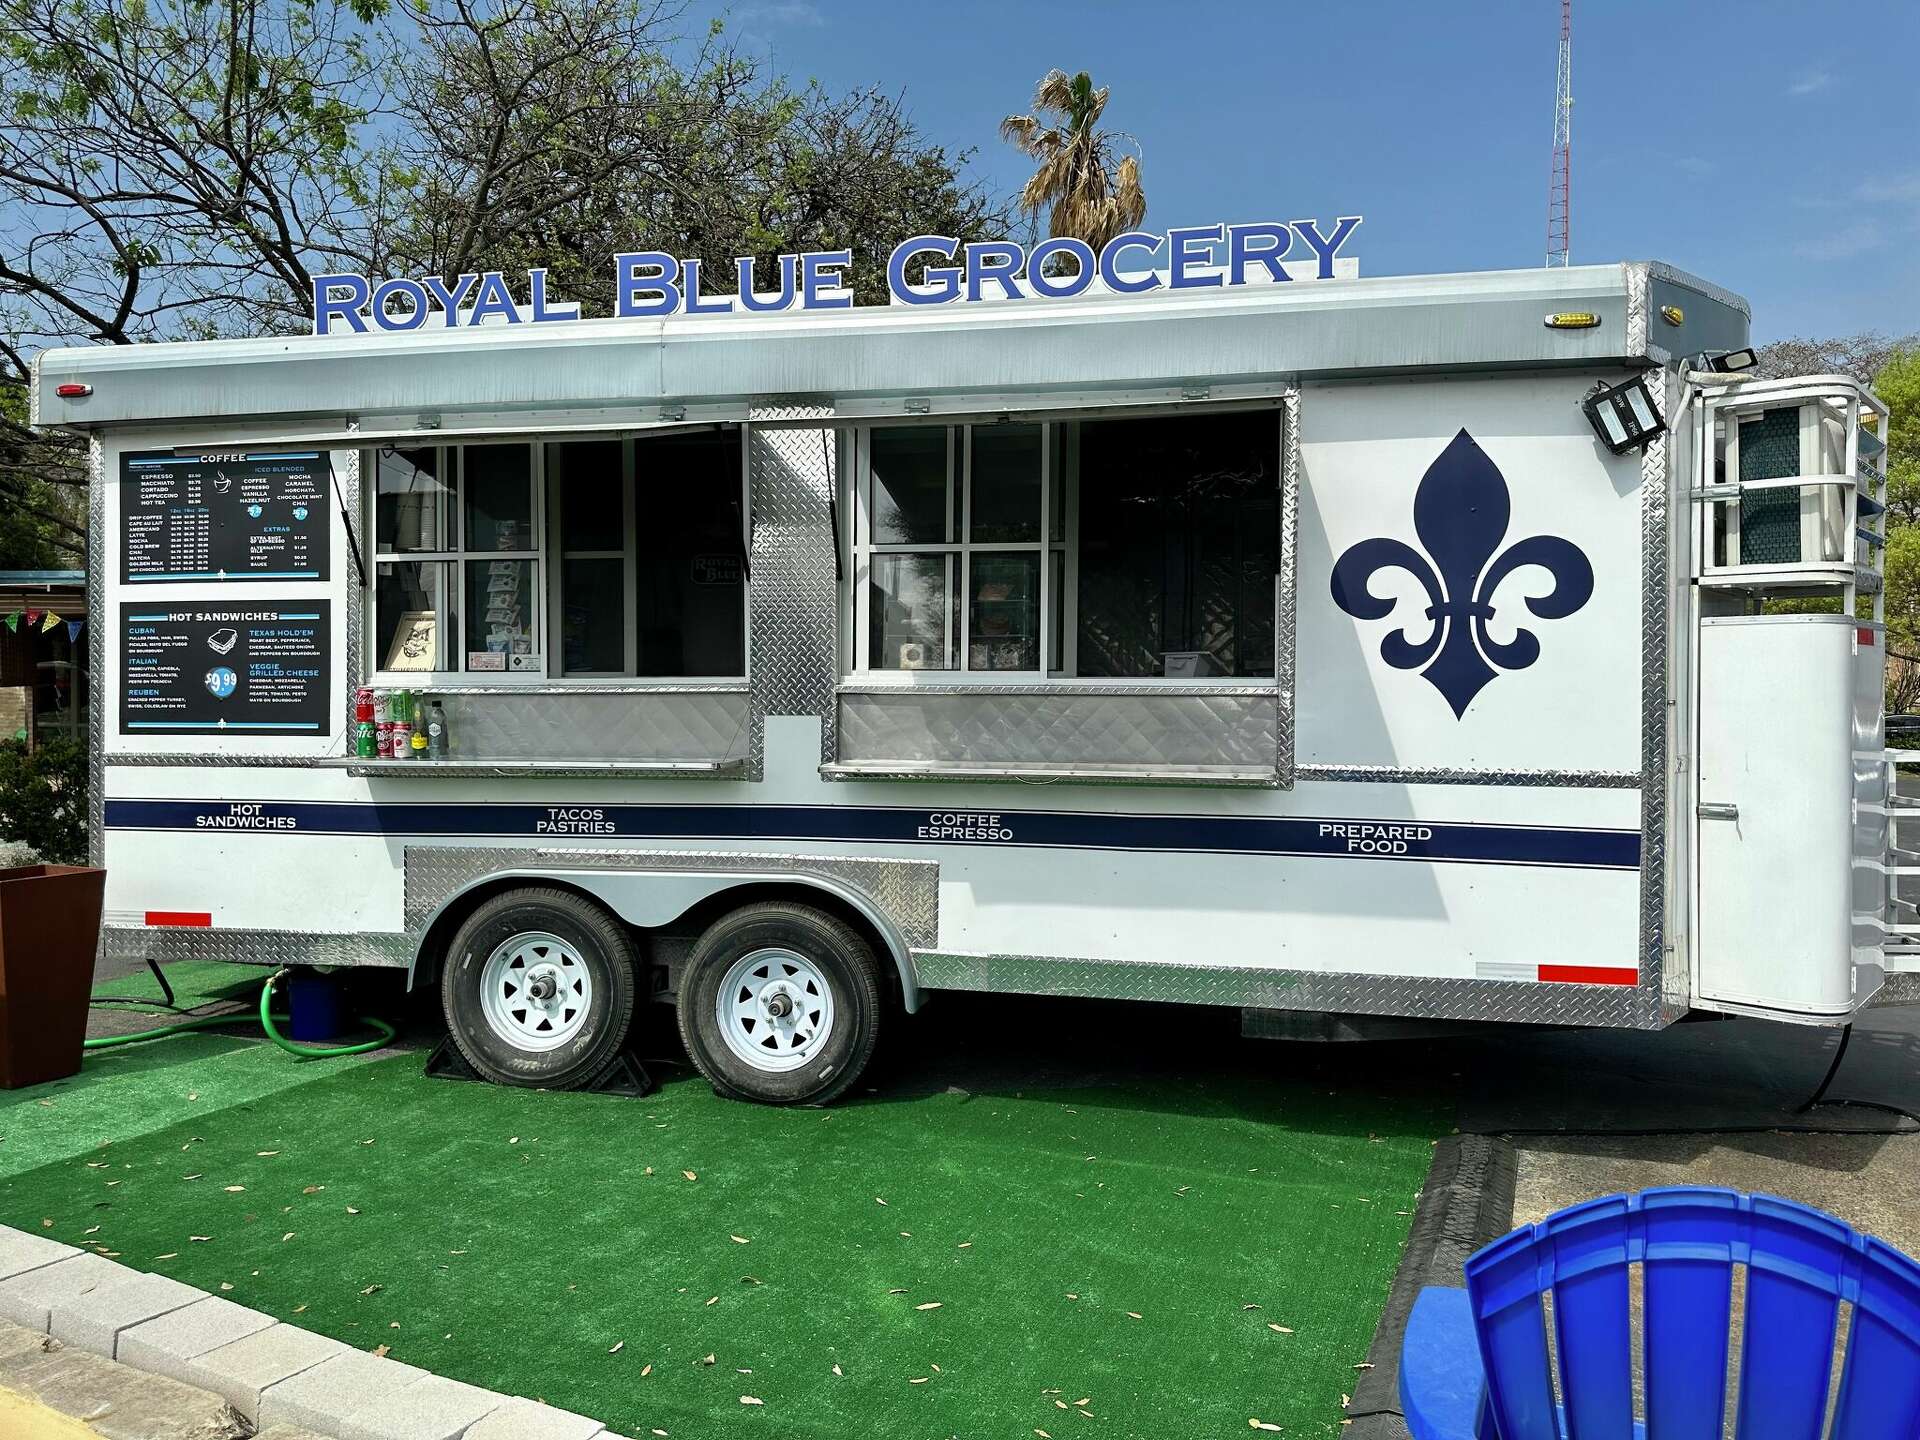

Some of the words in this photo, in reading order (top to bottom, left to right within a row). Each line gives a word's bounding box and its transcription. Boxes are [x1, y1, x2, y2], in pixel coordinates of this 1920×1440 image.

[310, 268, 579, 335] ROYAL
[614, 249, 852, 317] BLUE
[887, 216, 1362, 305] GROCERY
[200, 454, 246, 463] COFFEE
[169, 613, 193, 621] HOT
[196, 613, 278, 621] SANDWICHES
[205, 672, 237, 692] $9.99
[230, 804, 263, 816] HOT
[547, 808, 604, 820] TACOS
[196, 816, 297, 829] SANDWICHES
[929, 813, 1001, 827] COFFEE
[536, 821, 616, 833] PASTRIES
[918, 826, 1013, 840] ESPRESSO
[1319, 823, 1432, 840] PREPARED
[1348, 839, 1408, 854] FOOD
